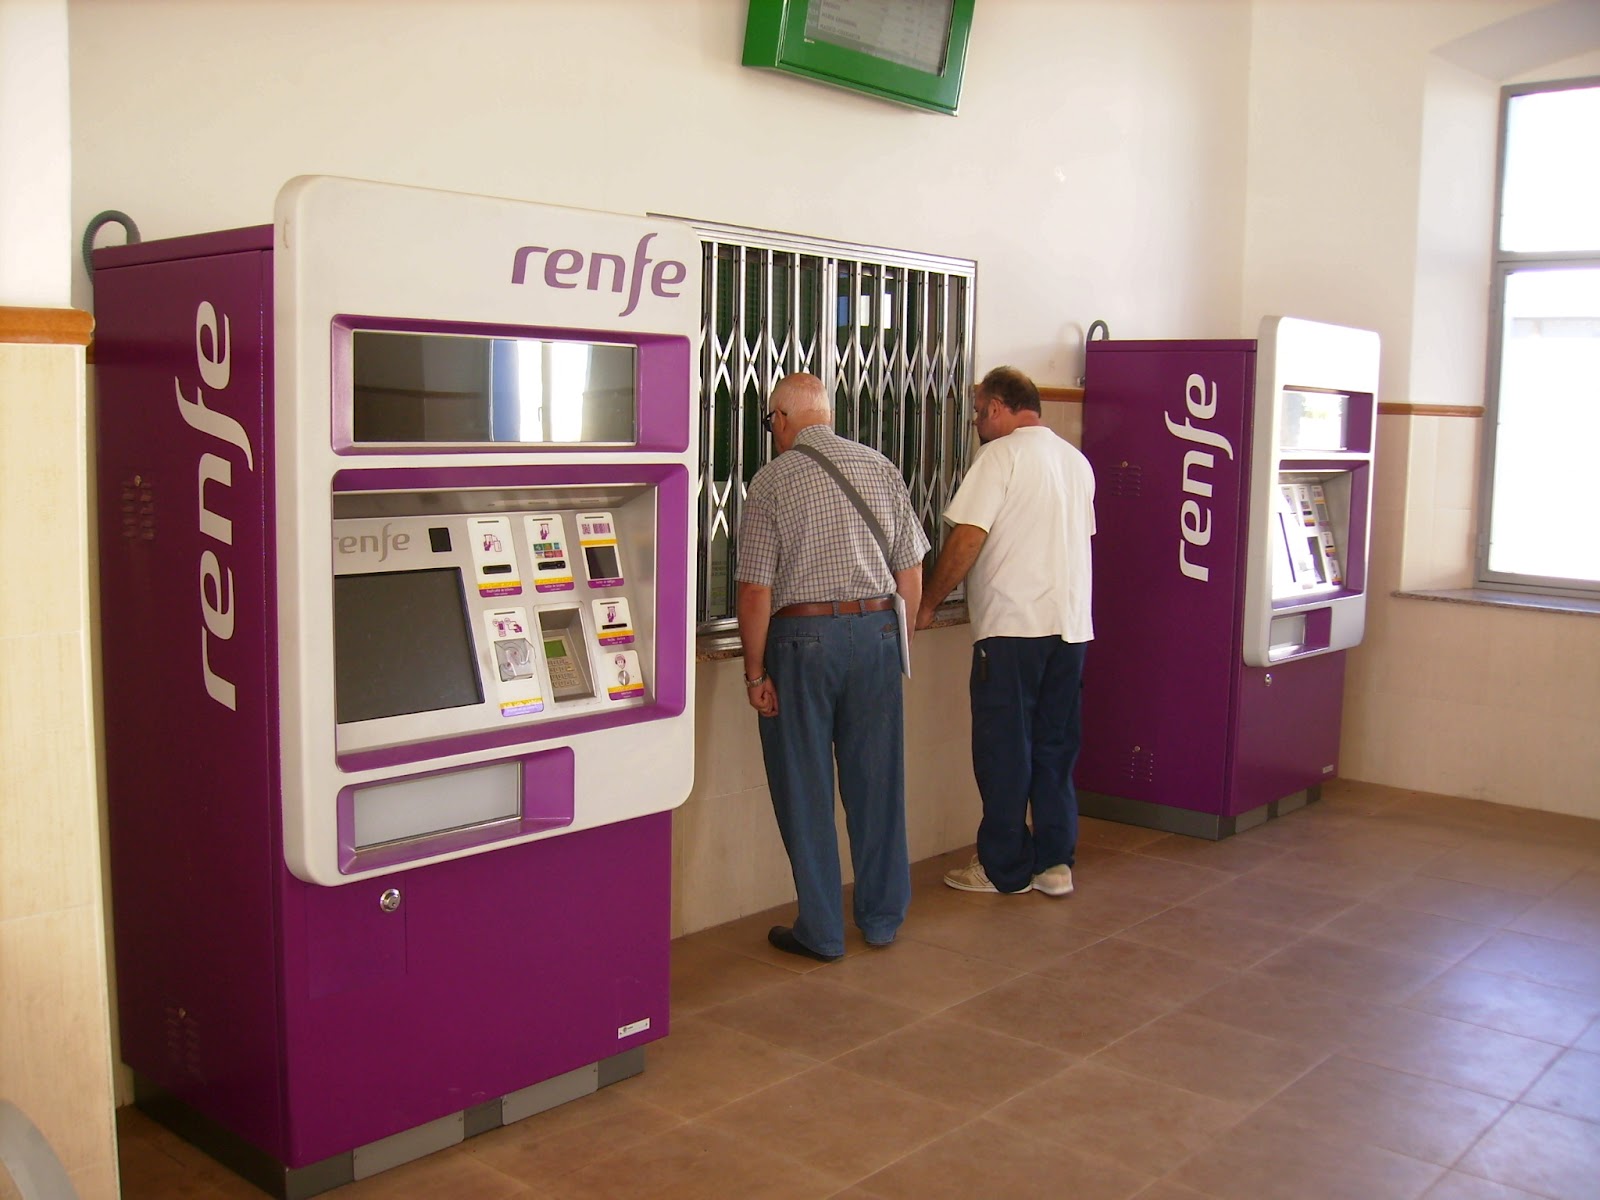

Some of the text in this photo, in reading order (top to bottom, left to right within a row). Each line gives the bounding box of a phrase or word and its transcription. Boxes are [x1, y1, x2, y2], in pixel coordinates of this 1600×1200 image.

[511, 232, 688, 317] renfe
[175, 300, 254, 712] renfe
[333, 522, 411, 562] enfe
[1164, 373, 1234, 582] renfe
